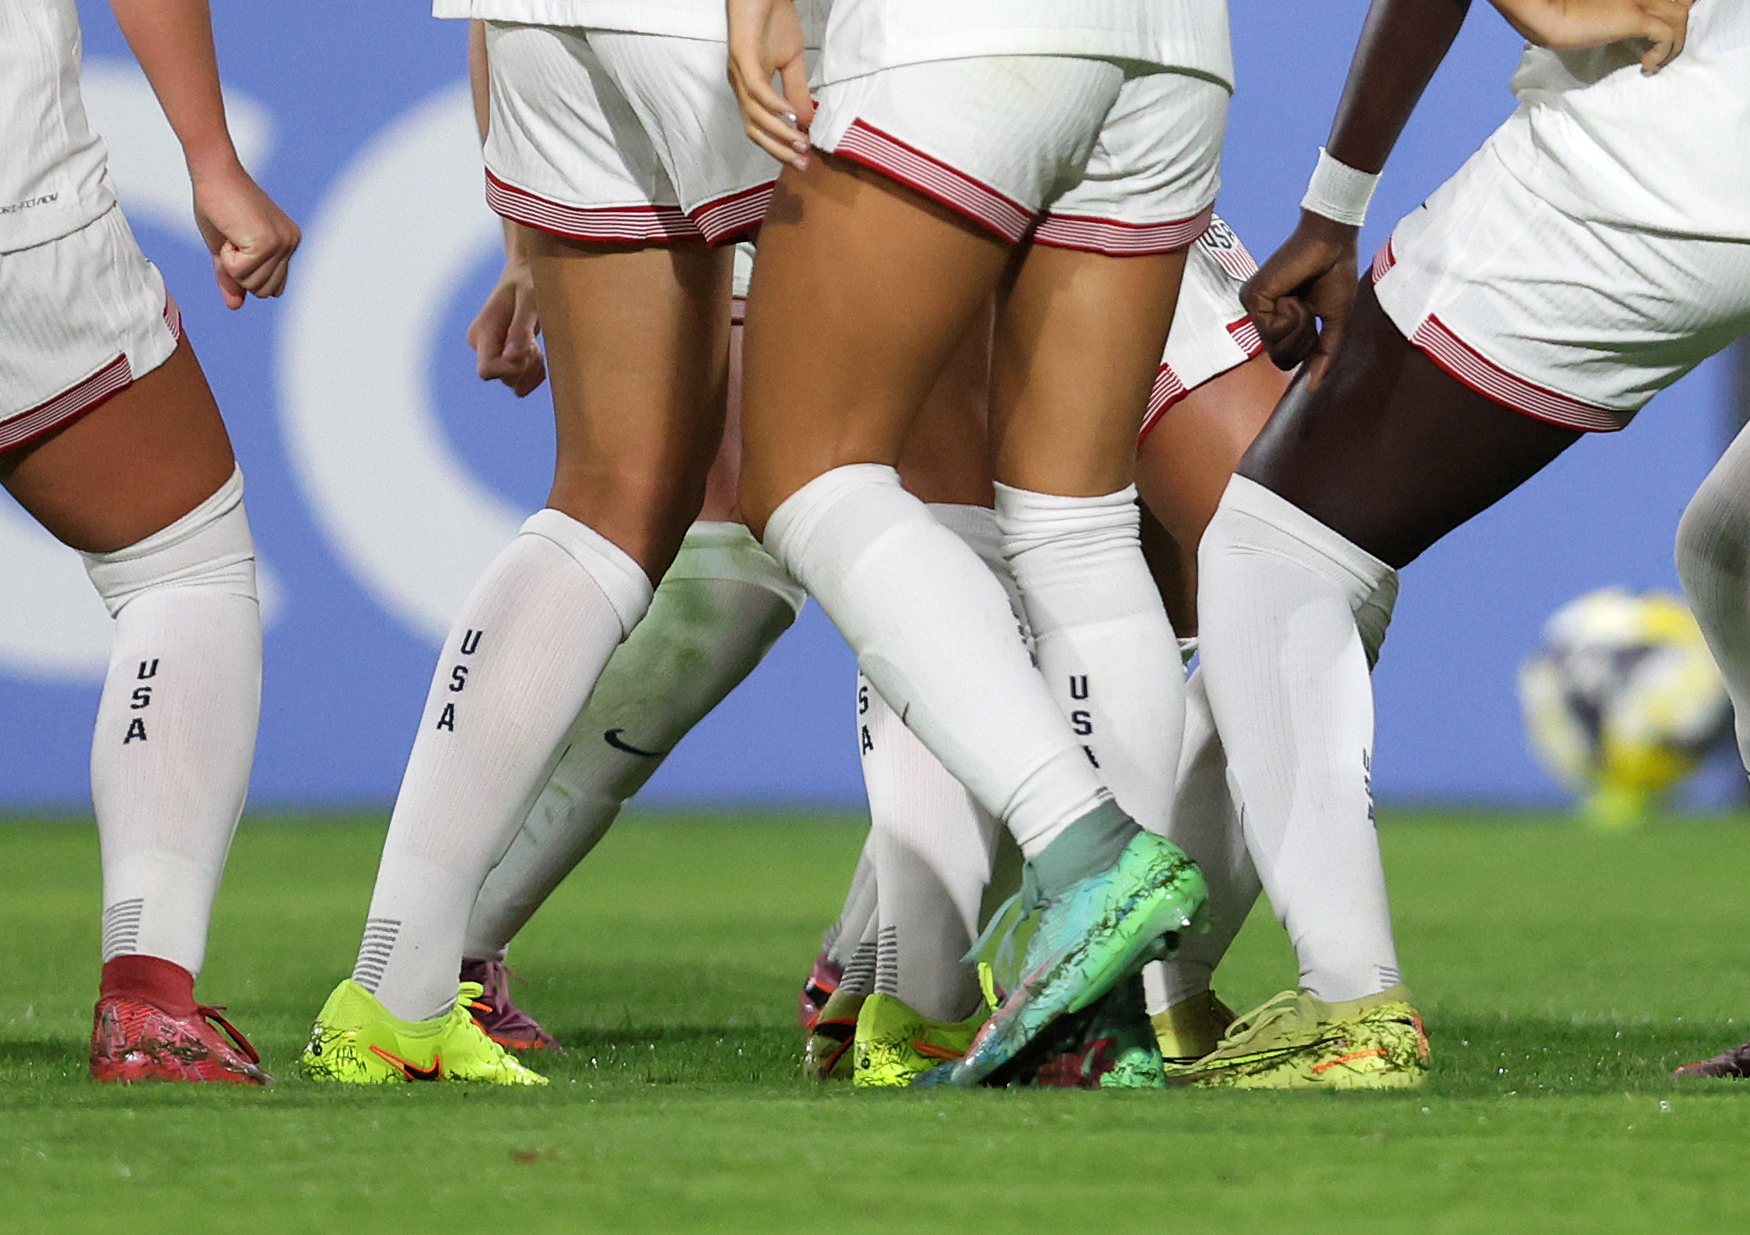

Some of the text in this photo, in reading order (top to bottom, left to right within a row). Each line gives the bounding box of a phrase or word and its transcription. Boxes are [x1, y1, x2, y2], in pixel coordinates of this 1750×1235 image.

[1202, 222, 1235, 250] USA
[123, 658, 160, 746] USA
[436, 629, 483, 732] USA
[859, 669, 874, 756] SA
